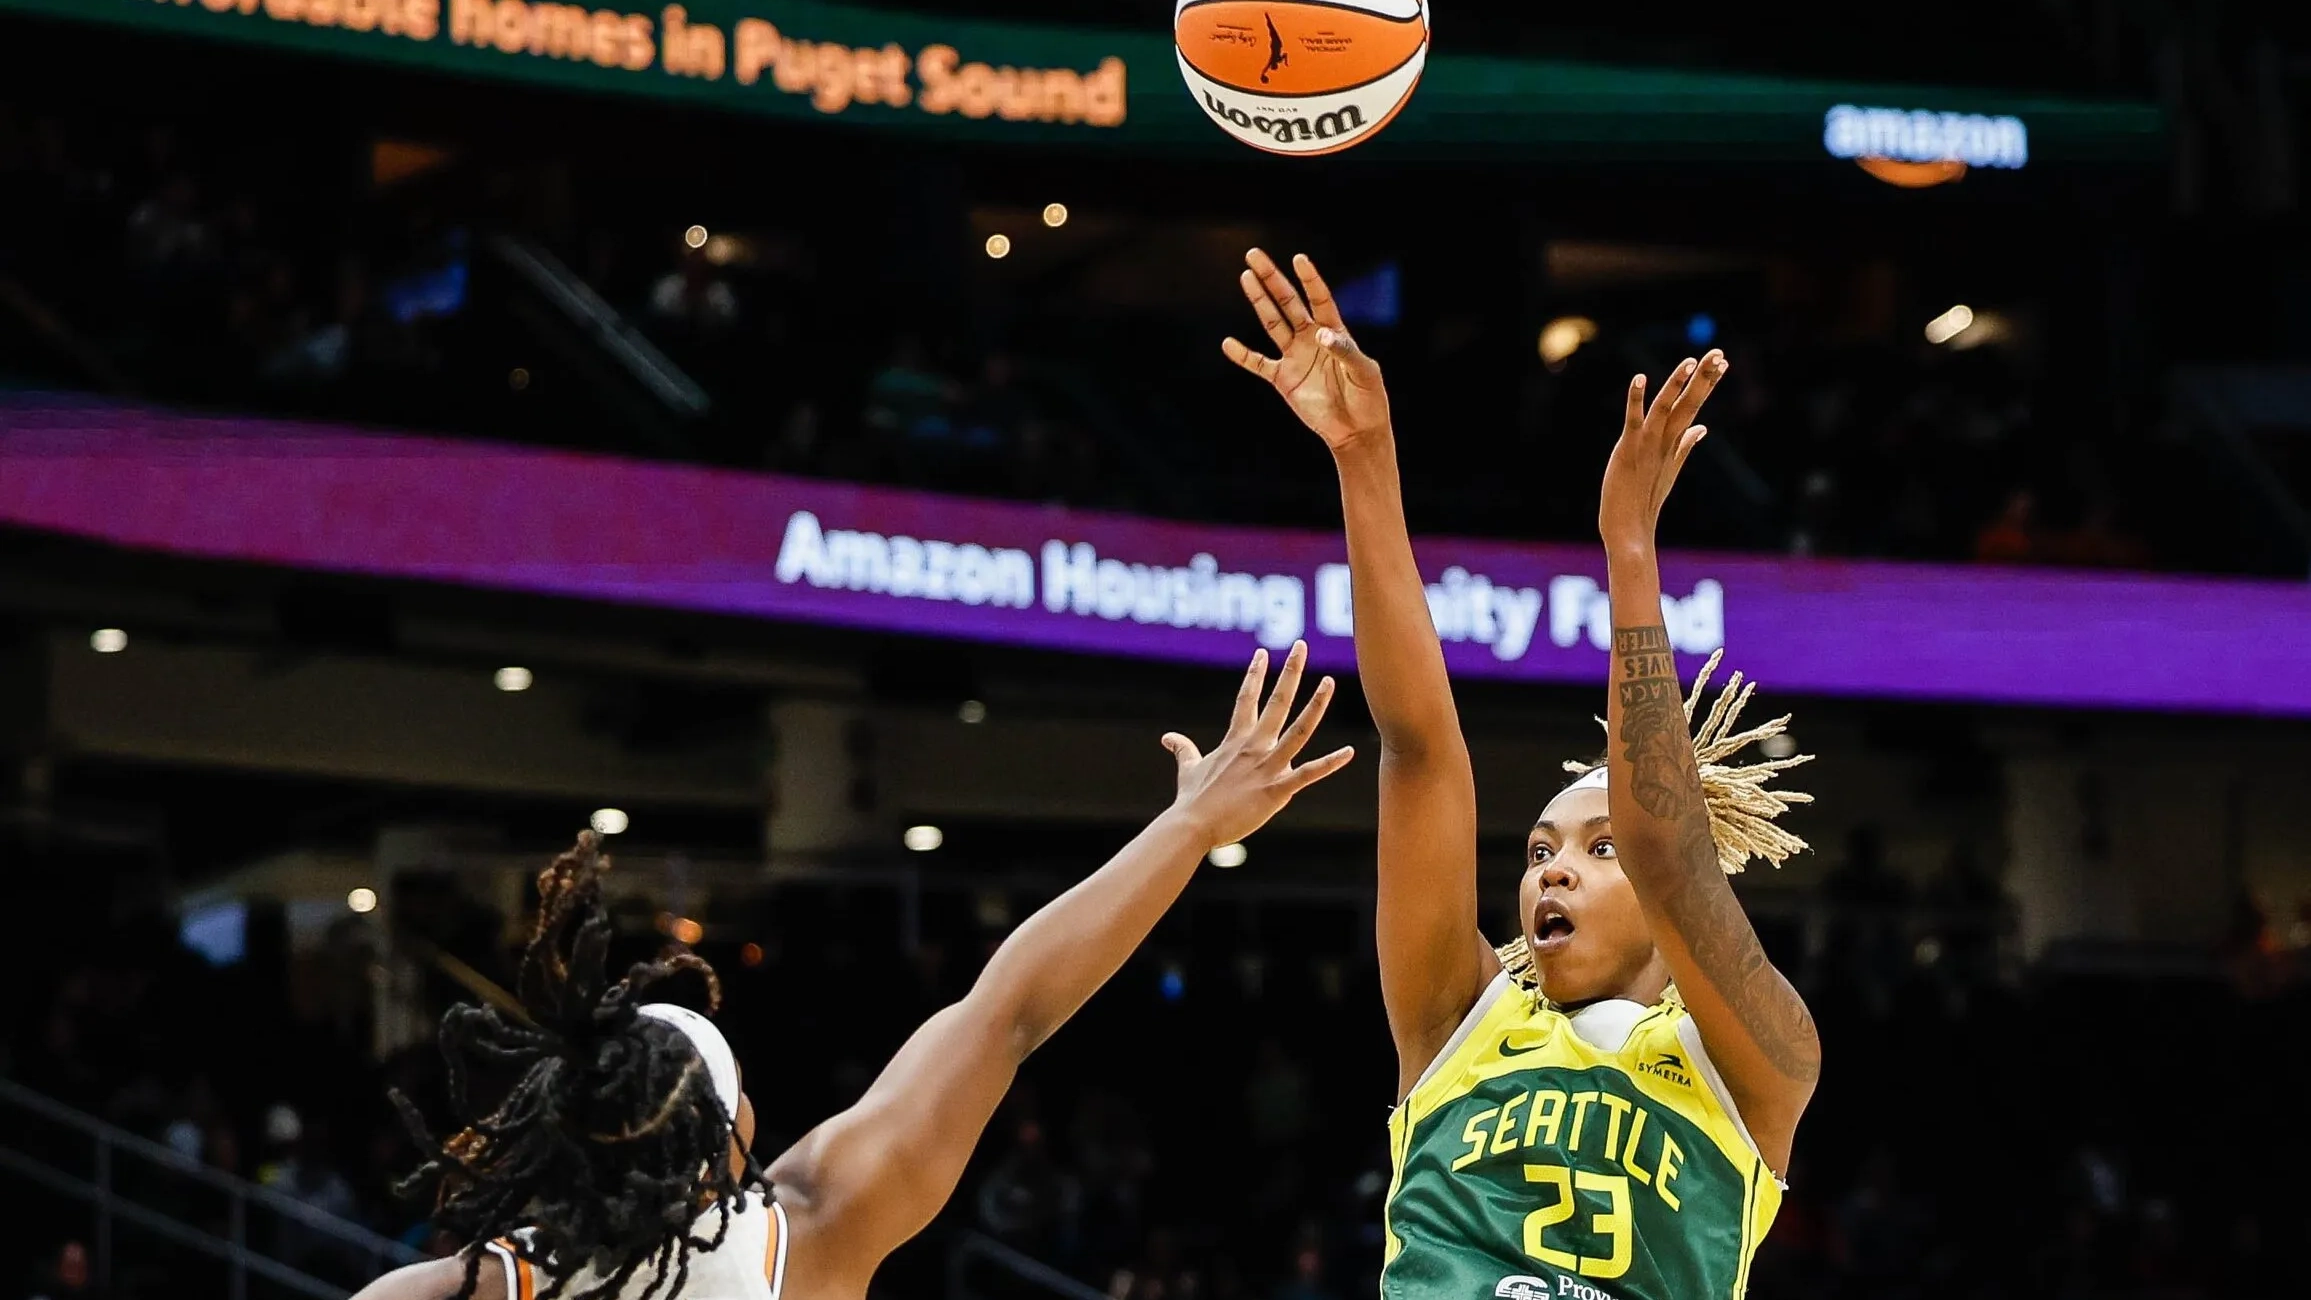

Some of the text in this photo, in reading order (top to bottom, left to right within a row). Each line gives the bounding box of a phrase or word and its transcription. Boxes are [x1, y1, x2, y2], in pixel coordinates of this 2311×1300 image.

[450, 0, 655, 70] homes
[662, 3, 725, 81] in
[734, 17, 911, 113] Puget
[917, 44, 1127, 127] Sound
[1203, 89, 1368, 143] Wilson
[1824, 104, 2028, 169] amazon
[775, 510, 1034, 609] Amazon
[1041, 538, 1305, 649] Housing
[1315, 562, 1543, 660] Eity
[1621, 682, 1677, 704] LACK
[1623, 654, 1672, 678] IVES
[1638, 1062, 1692, 1088] SYMETRA
[1451, 1089, 1686, 1213] SEATTLE
[1522, 1163, 1633, 1280] 23
[1557, 1274, 1619, 1300] Prov
